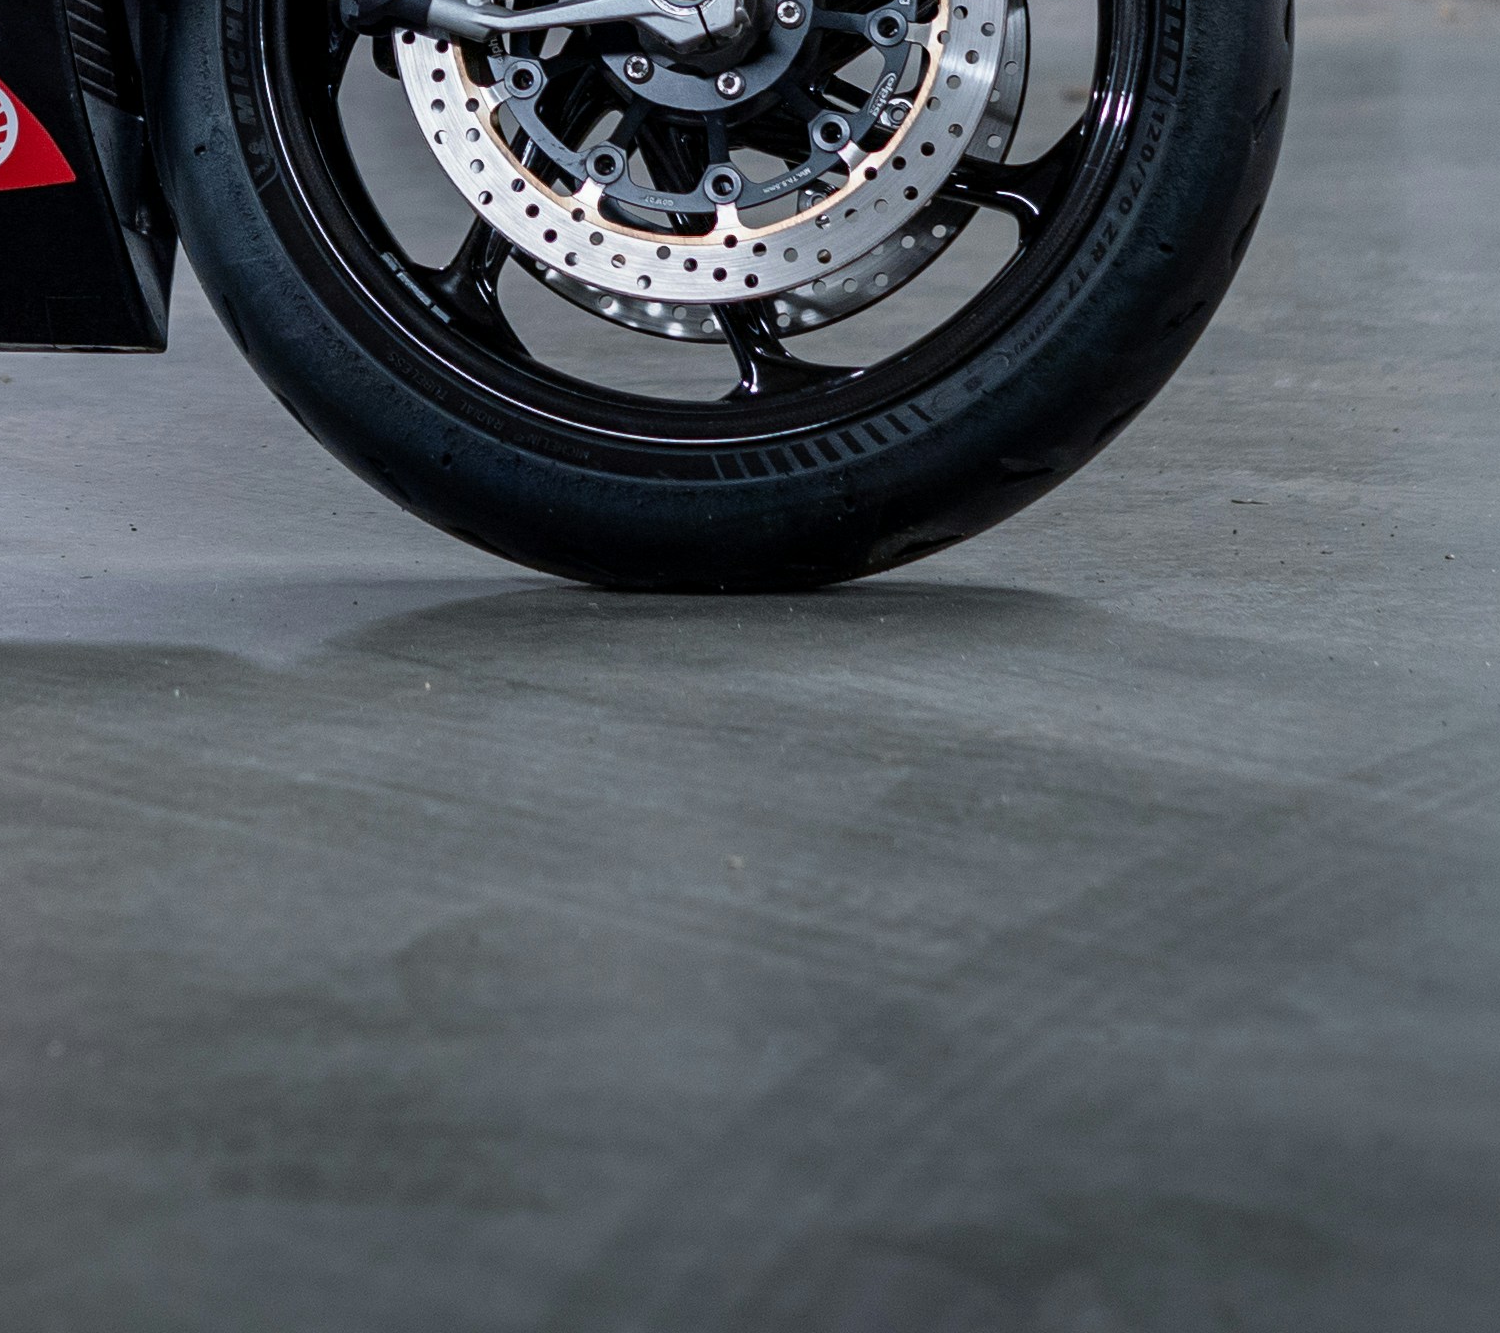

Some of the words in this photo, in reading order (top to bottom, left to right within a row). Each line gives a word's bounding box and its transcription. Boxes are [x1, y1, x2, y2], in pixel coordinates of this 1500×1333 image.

[1118, 109, 1166, 215] 120/70
[1090, 220, 1118, 263] ZR
[1067, 267, 1089, 300] 17
